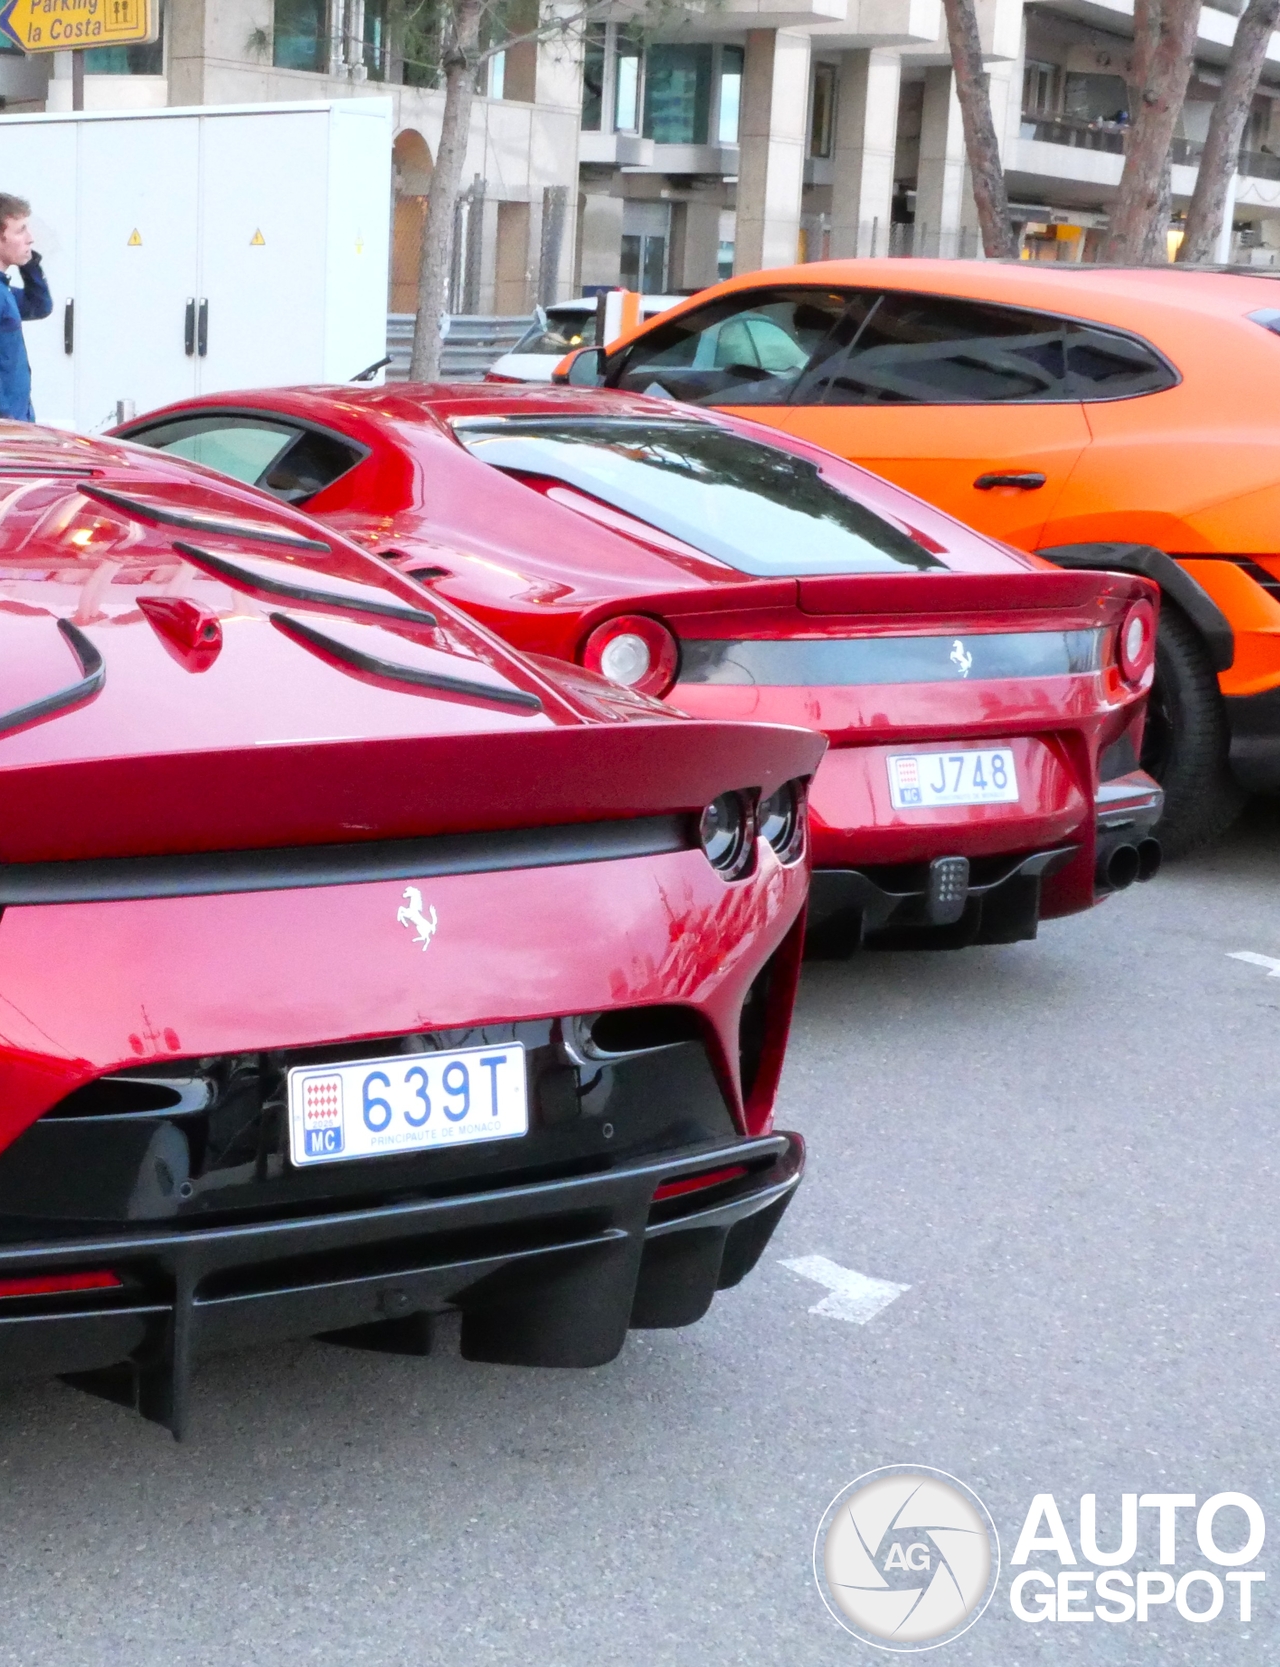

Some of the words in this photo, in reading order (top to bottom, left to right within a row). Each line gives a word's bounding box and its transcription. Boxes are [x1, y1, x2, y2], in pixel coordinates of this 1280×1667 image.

[31, 0, 98, 14] Parking
[28, 22, 42, 43] la
[50, 18, 102, 40] Costa
[930, 754, 1008, 793] J748
[903, 788, 919, 802] MC
[362, 1055, 507, 1132] 639T
[311, 1130, 336, 1151] MC
[370, 1129, 437, 1147] PRINCIPAUTE
[441, 1126, 454, 1138] DE
[458, 1120, 502, 1135] MONACO
